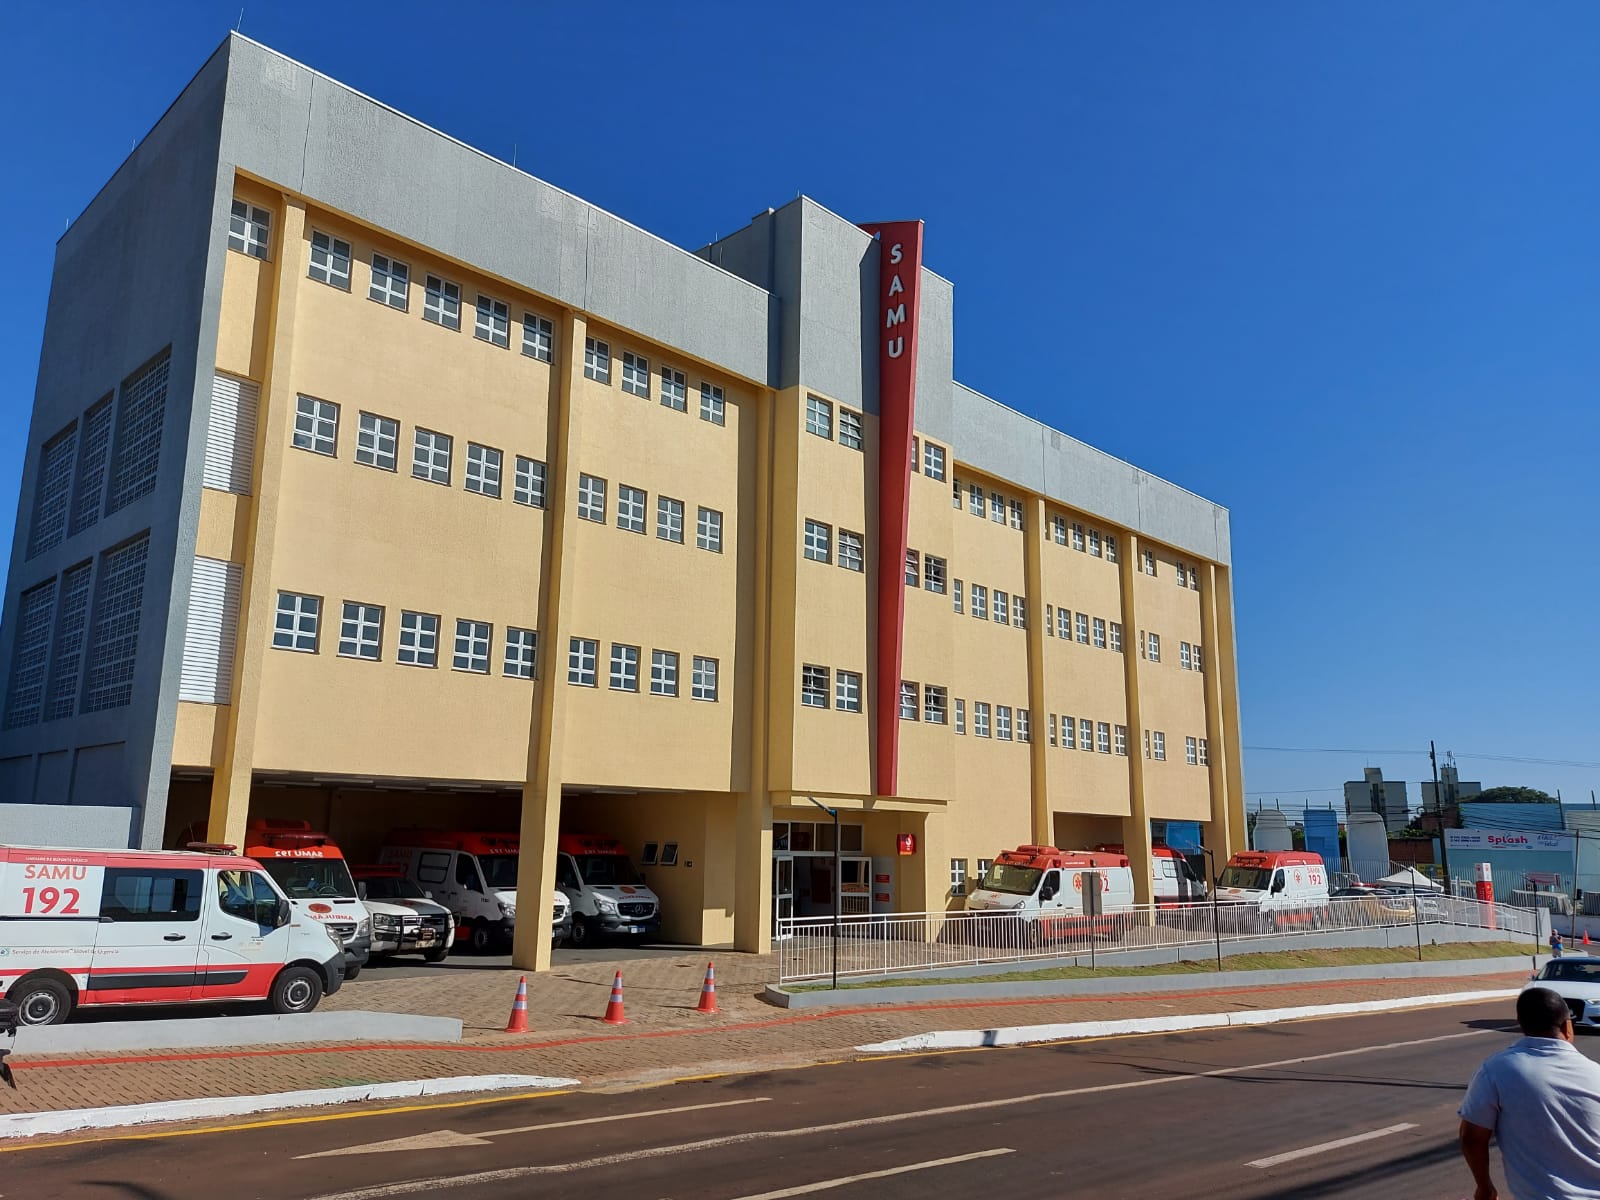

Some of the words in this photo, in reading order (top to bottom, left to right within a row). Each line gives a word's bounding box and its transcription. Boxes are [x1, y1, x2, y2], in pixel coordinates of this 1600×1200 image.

[887, 243, 906, 359] SAMU
[1487, 835, 1529, 845] Splash
[24, 864, 87, 880] SAMU
[1308, 874, 1322, 885] 192
[22, 887, 80, 914] 192
